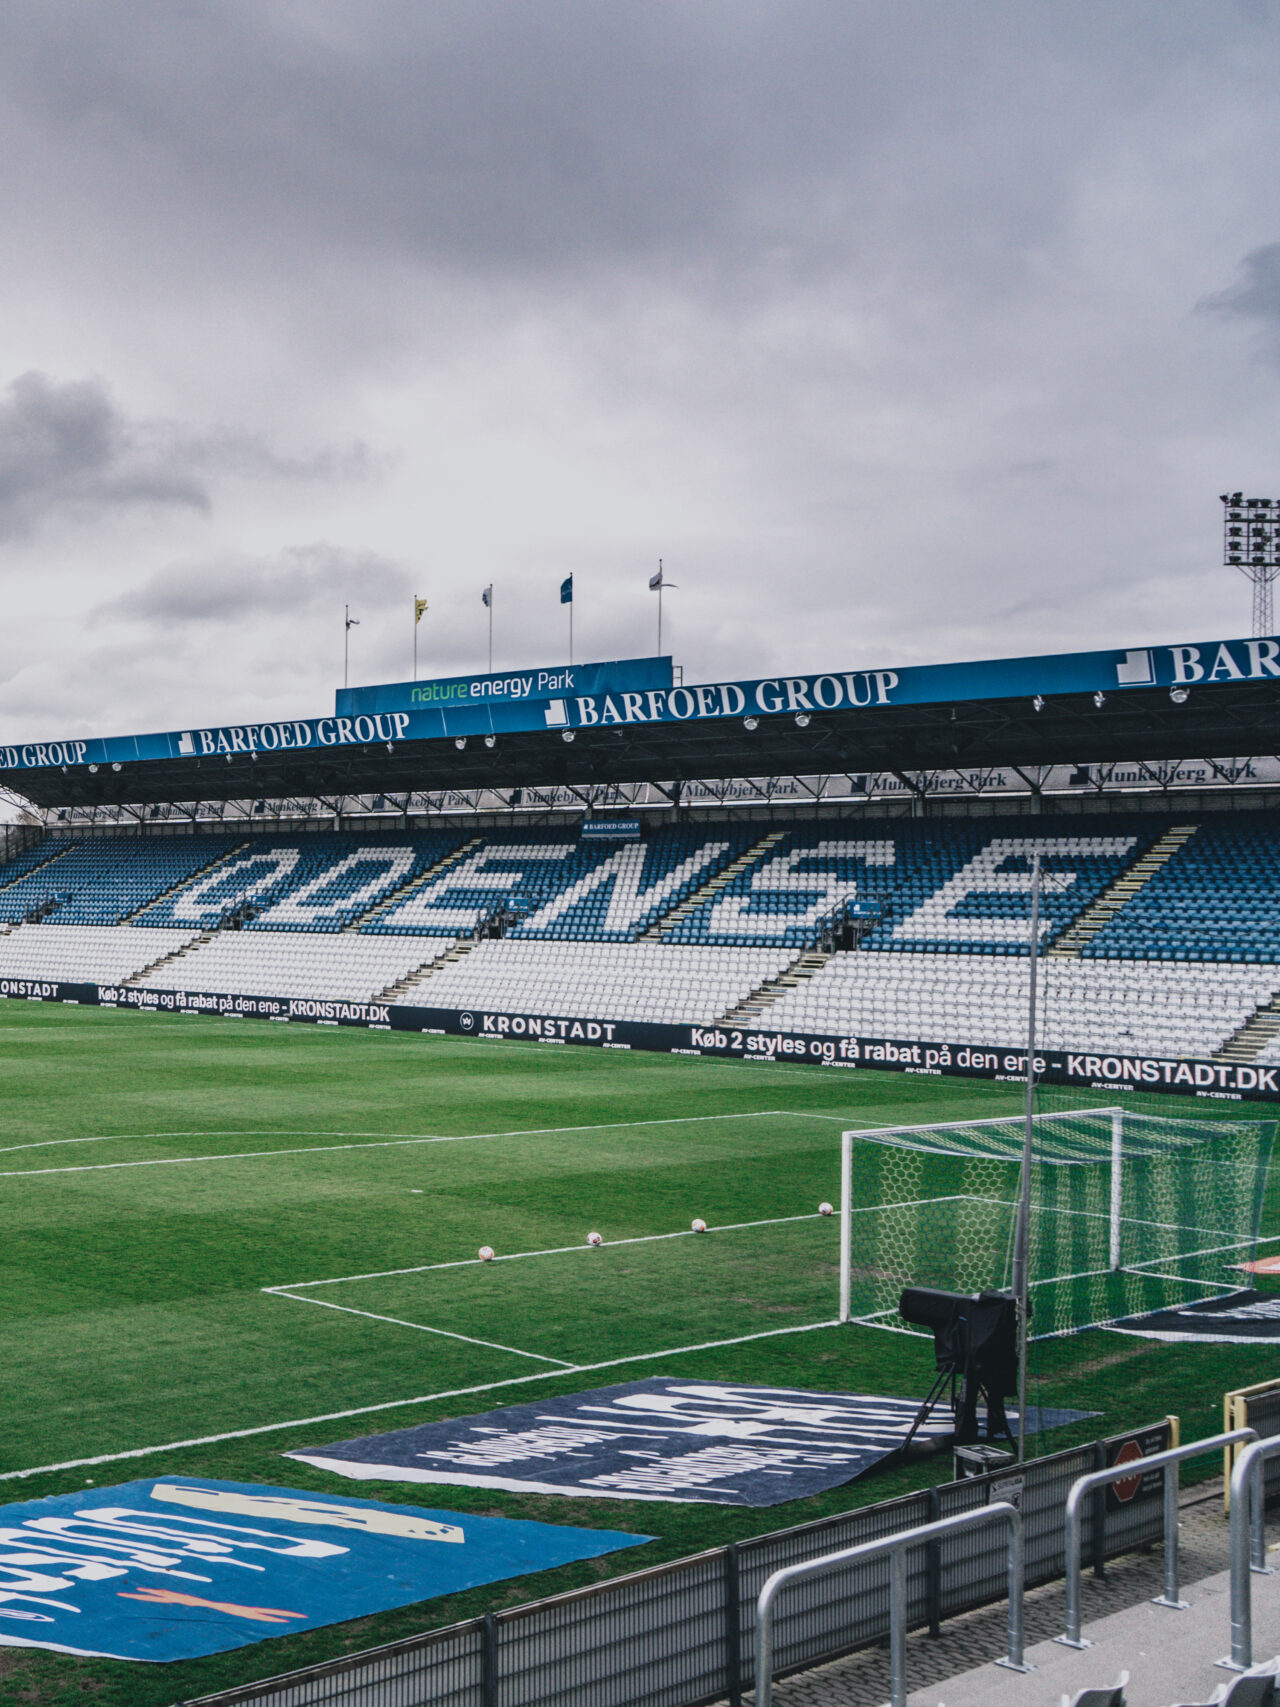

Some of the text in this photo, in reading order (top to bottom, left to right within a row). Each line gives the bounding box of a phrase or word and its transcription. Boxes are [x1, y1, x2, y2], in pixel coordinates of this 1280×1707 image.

[1168, 639, 1280, 684] BAR
[412, 670, 574, 702] nature energy Park
[575, 670, 899, 726] BARFOED GROUP
[198, 713, 410, 754] BARFOED GROUP
[22, 741, 87, 767] GROUP
[766, 781, 798, 794] Park
[970, 773, 1007, 787] Park
[1212, 763, 1257, 779] Park
[173, 836, 1138, 942] ODENSE
[98, 987, 118, 1001] Køb
[120, 988, 127, 1001] 2
[127, 990, 159, 1006] styles
[160, 994, 174, 1008] og
[175, 991, 187, 1007] få
[188, 994, 218, 1009] rabat
[219, 995, 233, 1012] på
[235, 997, 256, 1011] den
[259, 1001, 280, 1014] ene
[289, 1000, 390, 1022] KRONSTADT.DK
[483, 1015, 616, 1040] KRONSTADT
[691, 1028, 727, 1048] Køb
[731, 1031, 743, 1049] 2
[747, 1034, 806, 1056] styles
[810, 1041, 835, 1061] og
[839, 1037, 860, 1059] få
[864, 1042, 921, 1064] rabat
[925, 1045, 952, 1068] på
[957, 1048, 998, 1069] den
[1067, 1055, 1279, 1092] KRONSTADT.DK
